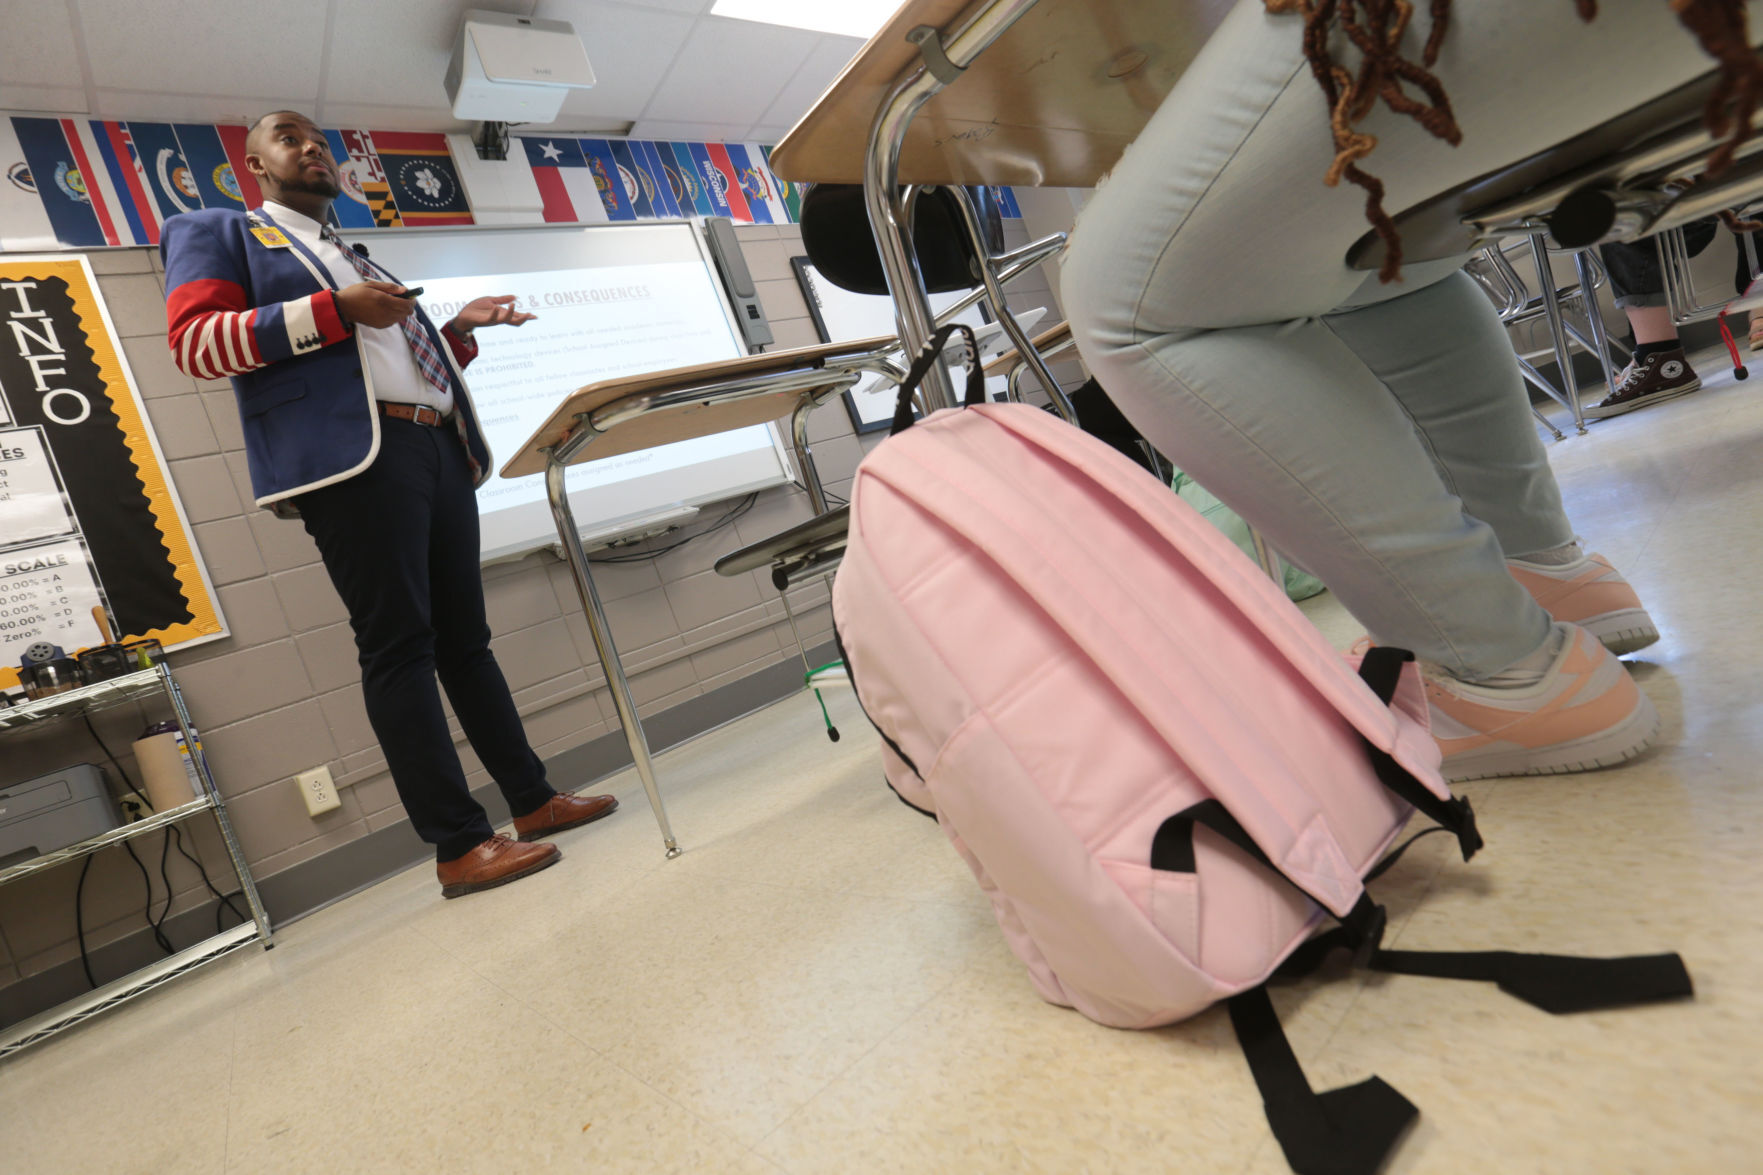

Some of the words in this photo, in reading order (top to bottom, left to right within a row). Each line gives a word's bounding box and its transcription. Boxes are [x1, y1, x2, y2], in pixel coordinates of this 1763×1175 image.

[702, 160, 728, 208] WISCONSIN
[527, 294, 541, 308] &
[543, 284, 651, 307] CONSEQUENCES
[1, 282, 91, 426] INFO
[0, 447, 25, 460] ES
[4, 553, 68, 574] SCALE
[53, 573, 61, 581] A
[60, 596, 69, 604] C
[63, 608, 72, 616] D
[3, 628, 42, 643] Zero%
